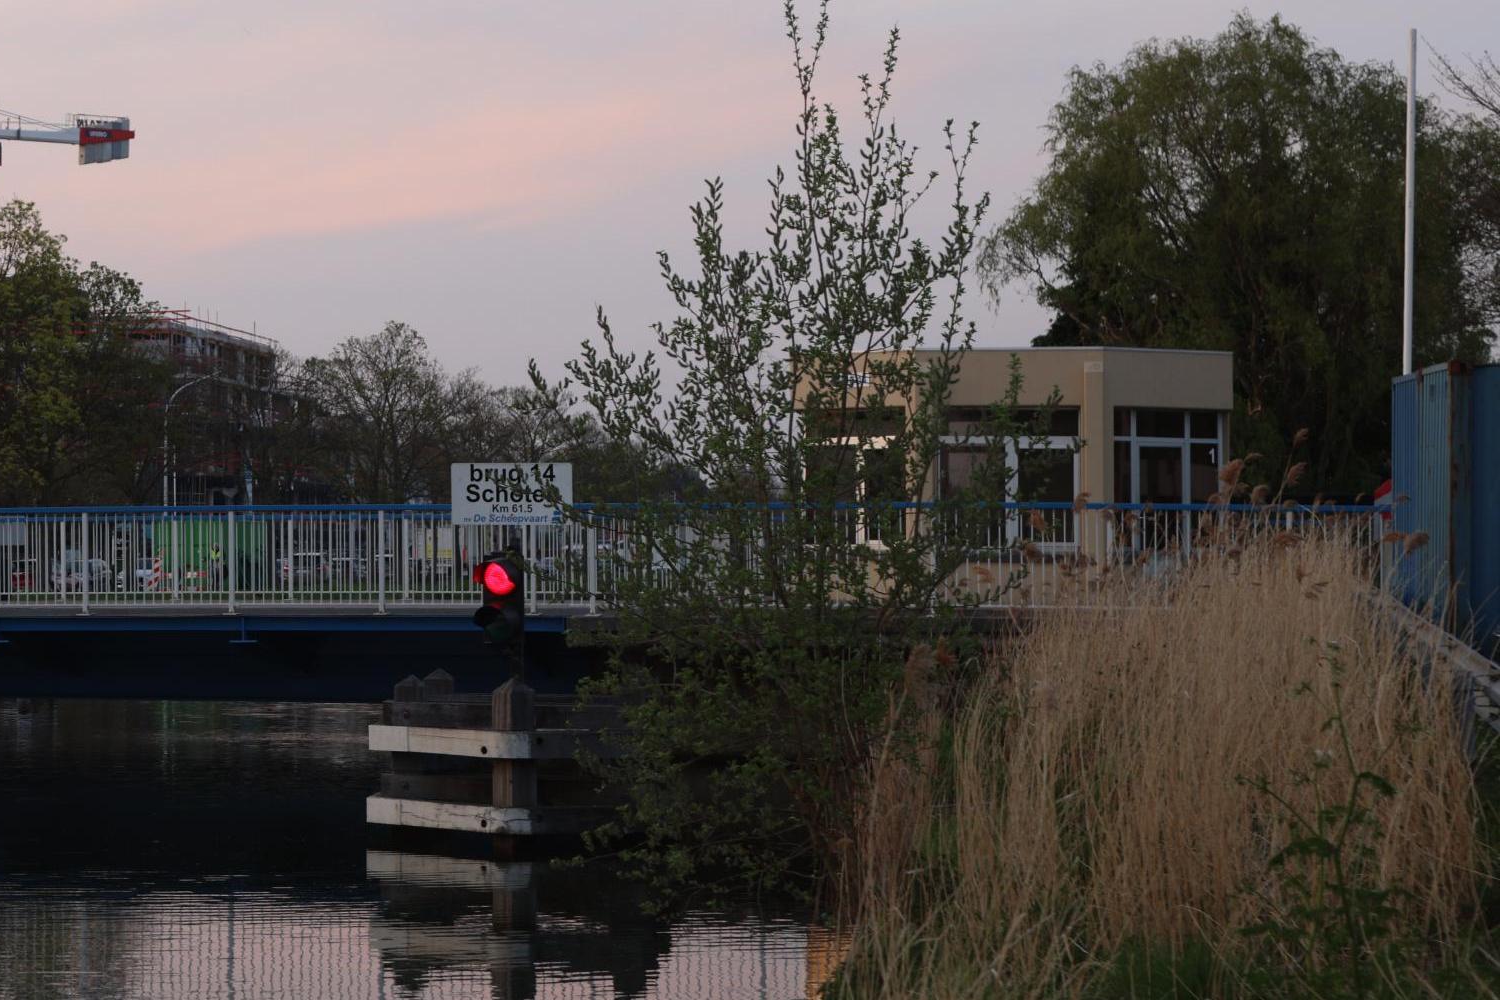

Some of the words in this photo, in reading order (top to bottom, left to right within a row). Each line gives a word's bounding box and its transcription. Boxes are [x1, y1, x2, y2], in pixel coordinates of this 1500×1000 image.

[470, 464, 521, 484] brug
[530, 464, 556, 482] 14
[466, 484, 555, 503] Schote
[492, 504, 509, 513] Km
[512, 504, 533, 513] 61.5
[473, 514, 486, 523] De
[489, 514, 548, 524] Scheepvaart
